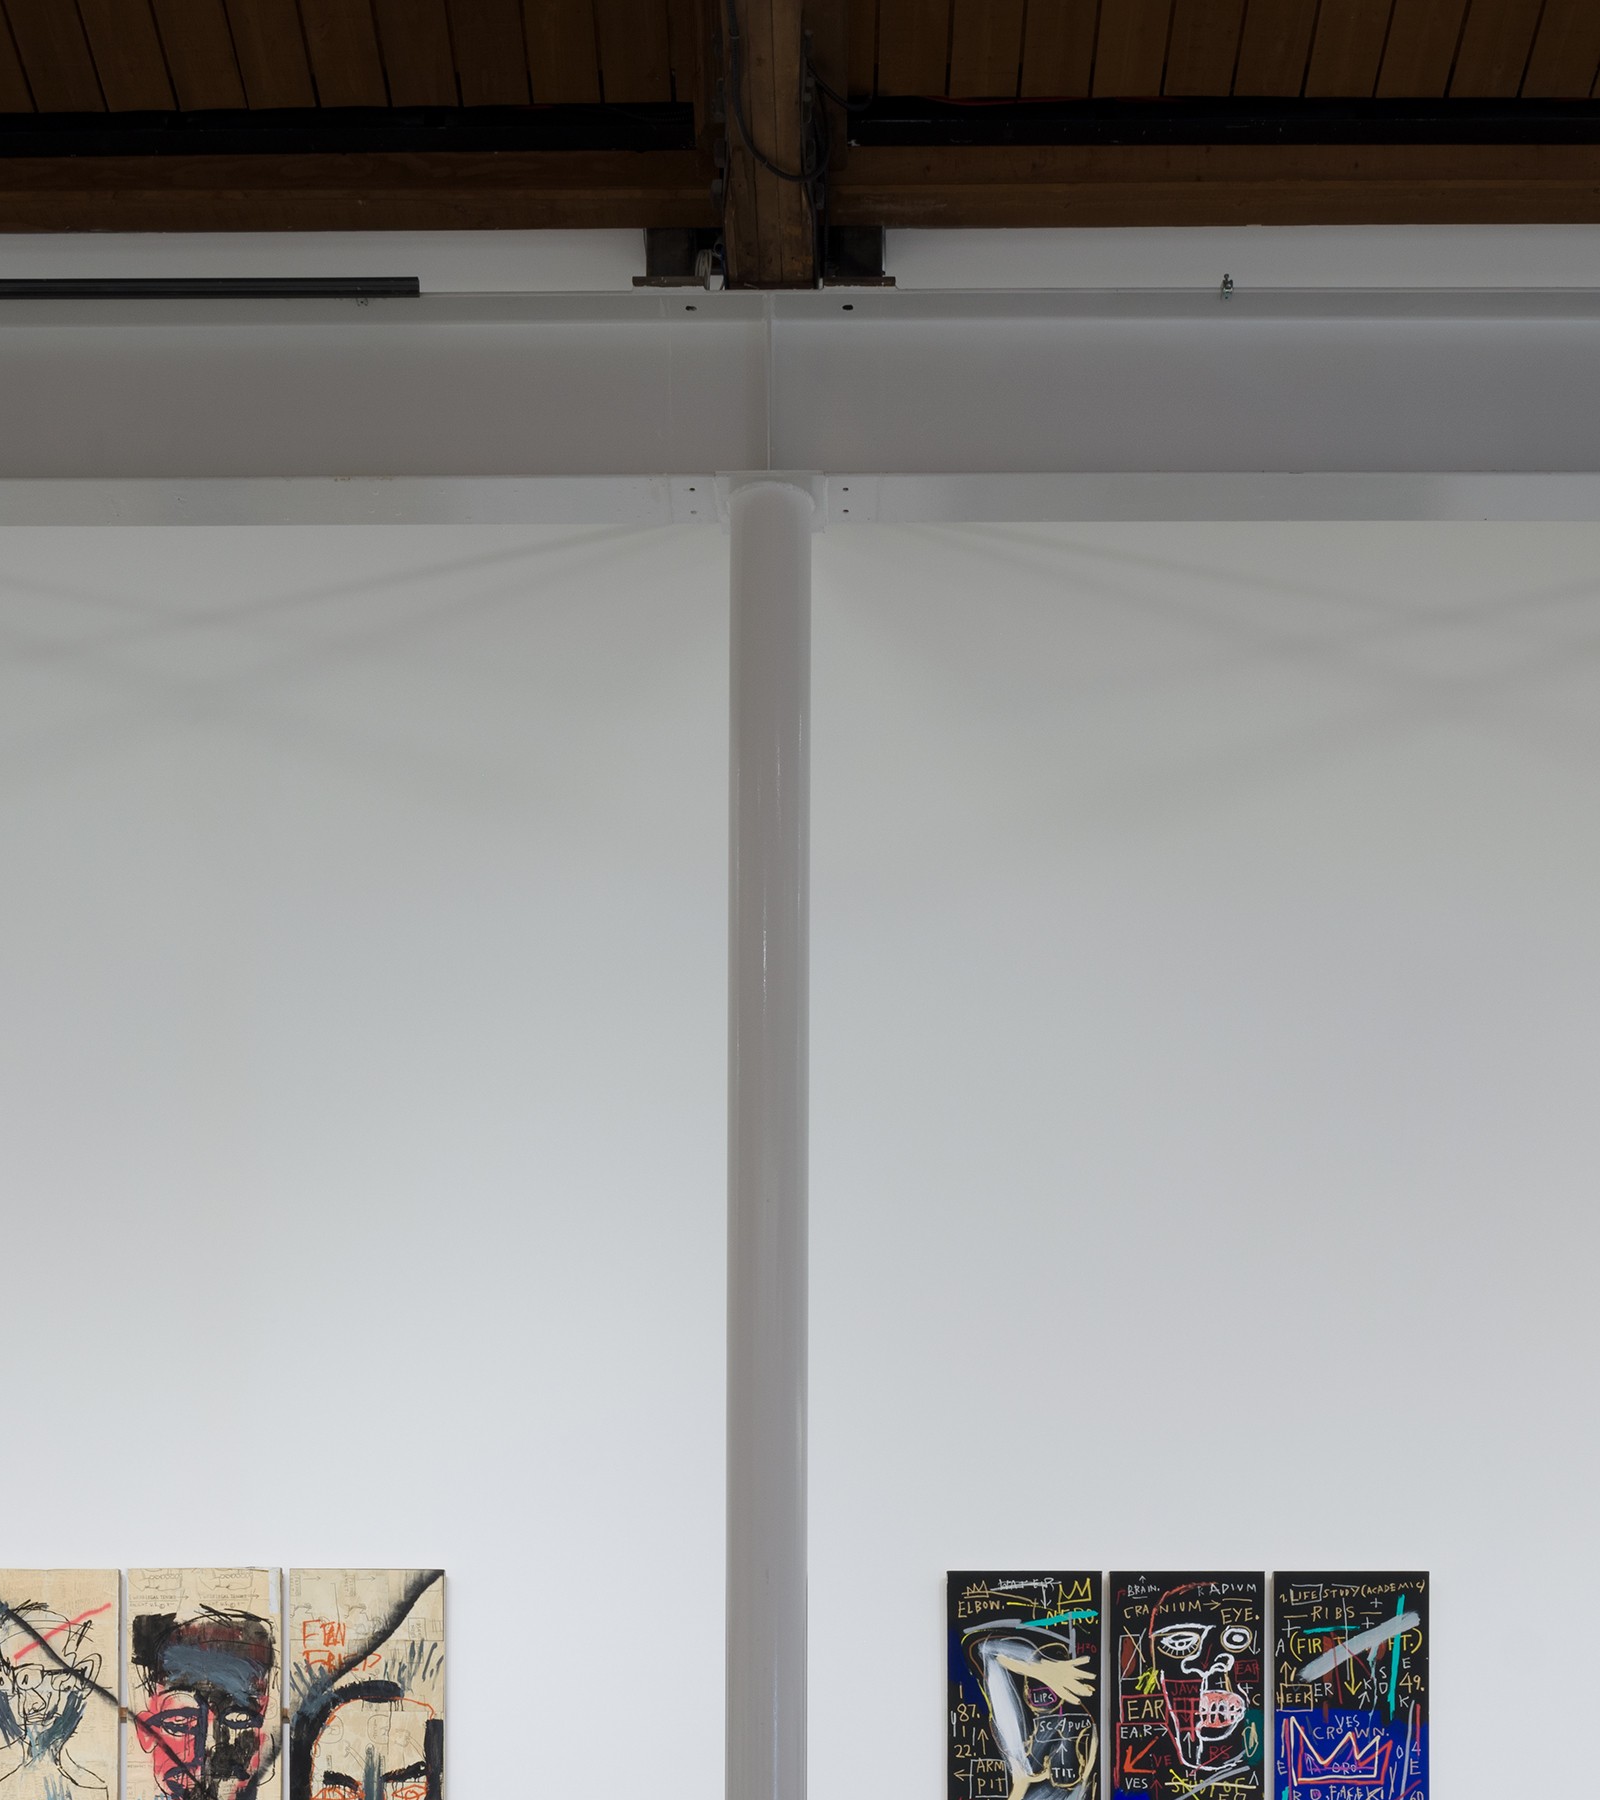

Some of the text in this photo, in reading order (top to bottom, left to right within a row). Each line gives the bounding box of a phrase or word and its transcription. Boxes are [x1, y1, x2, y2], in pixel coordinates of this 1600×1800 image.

[1033, 1692, 1054, 1704] LIPS
[1127, 1699, 1166, 1721] EAR
[976, 1760, 1005, 1774] ARM
[977, 1777, 1006, 1795] PIT
